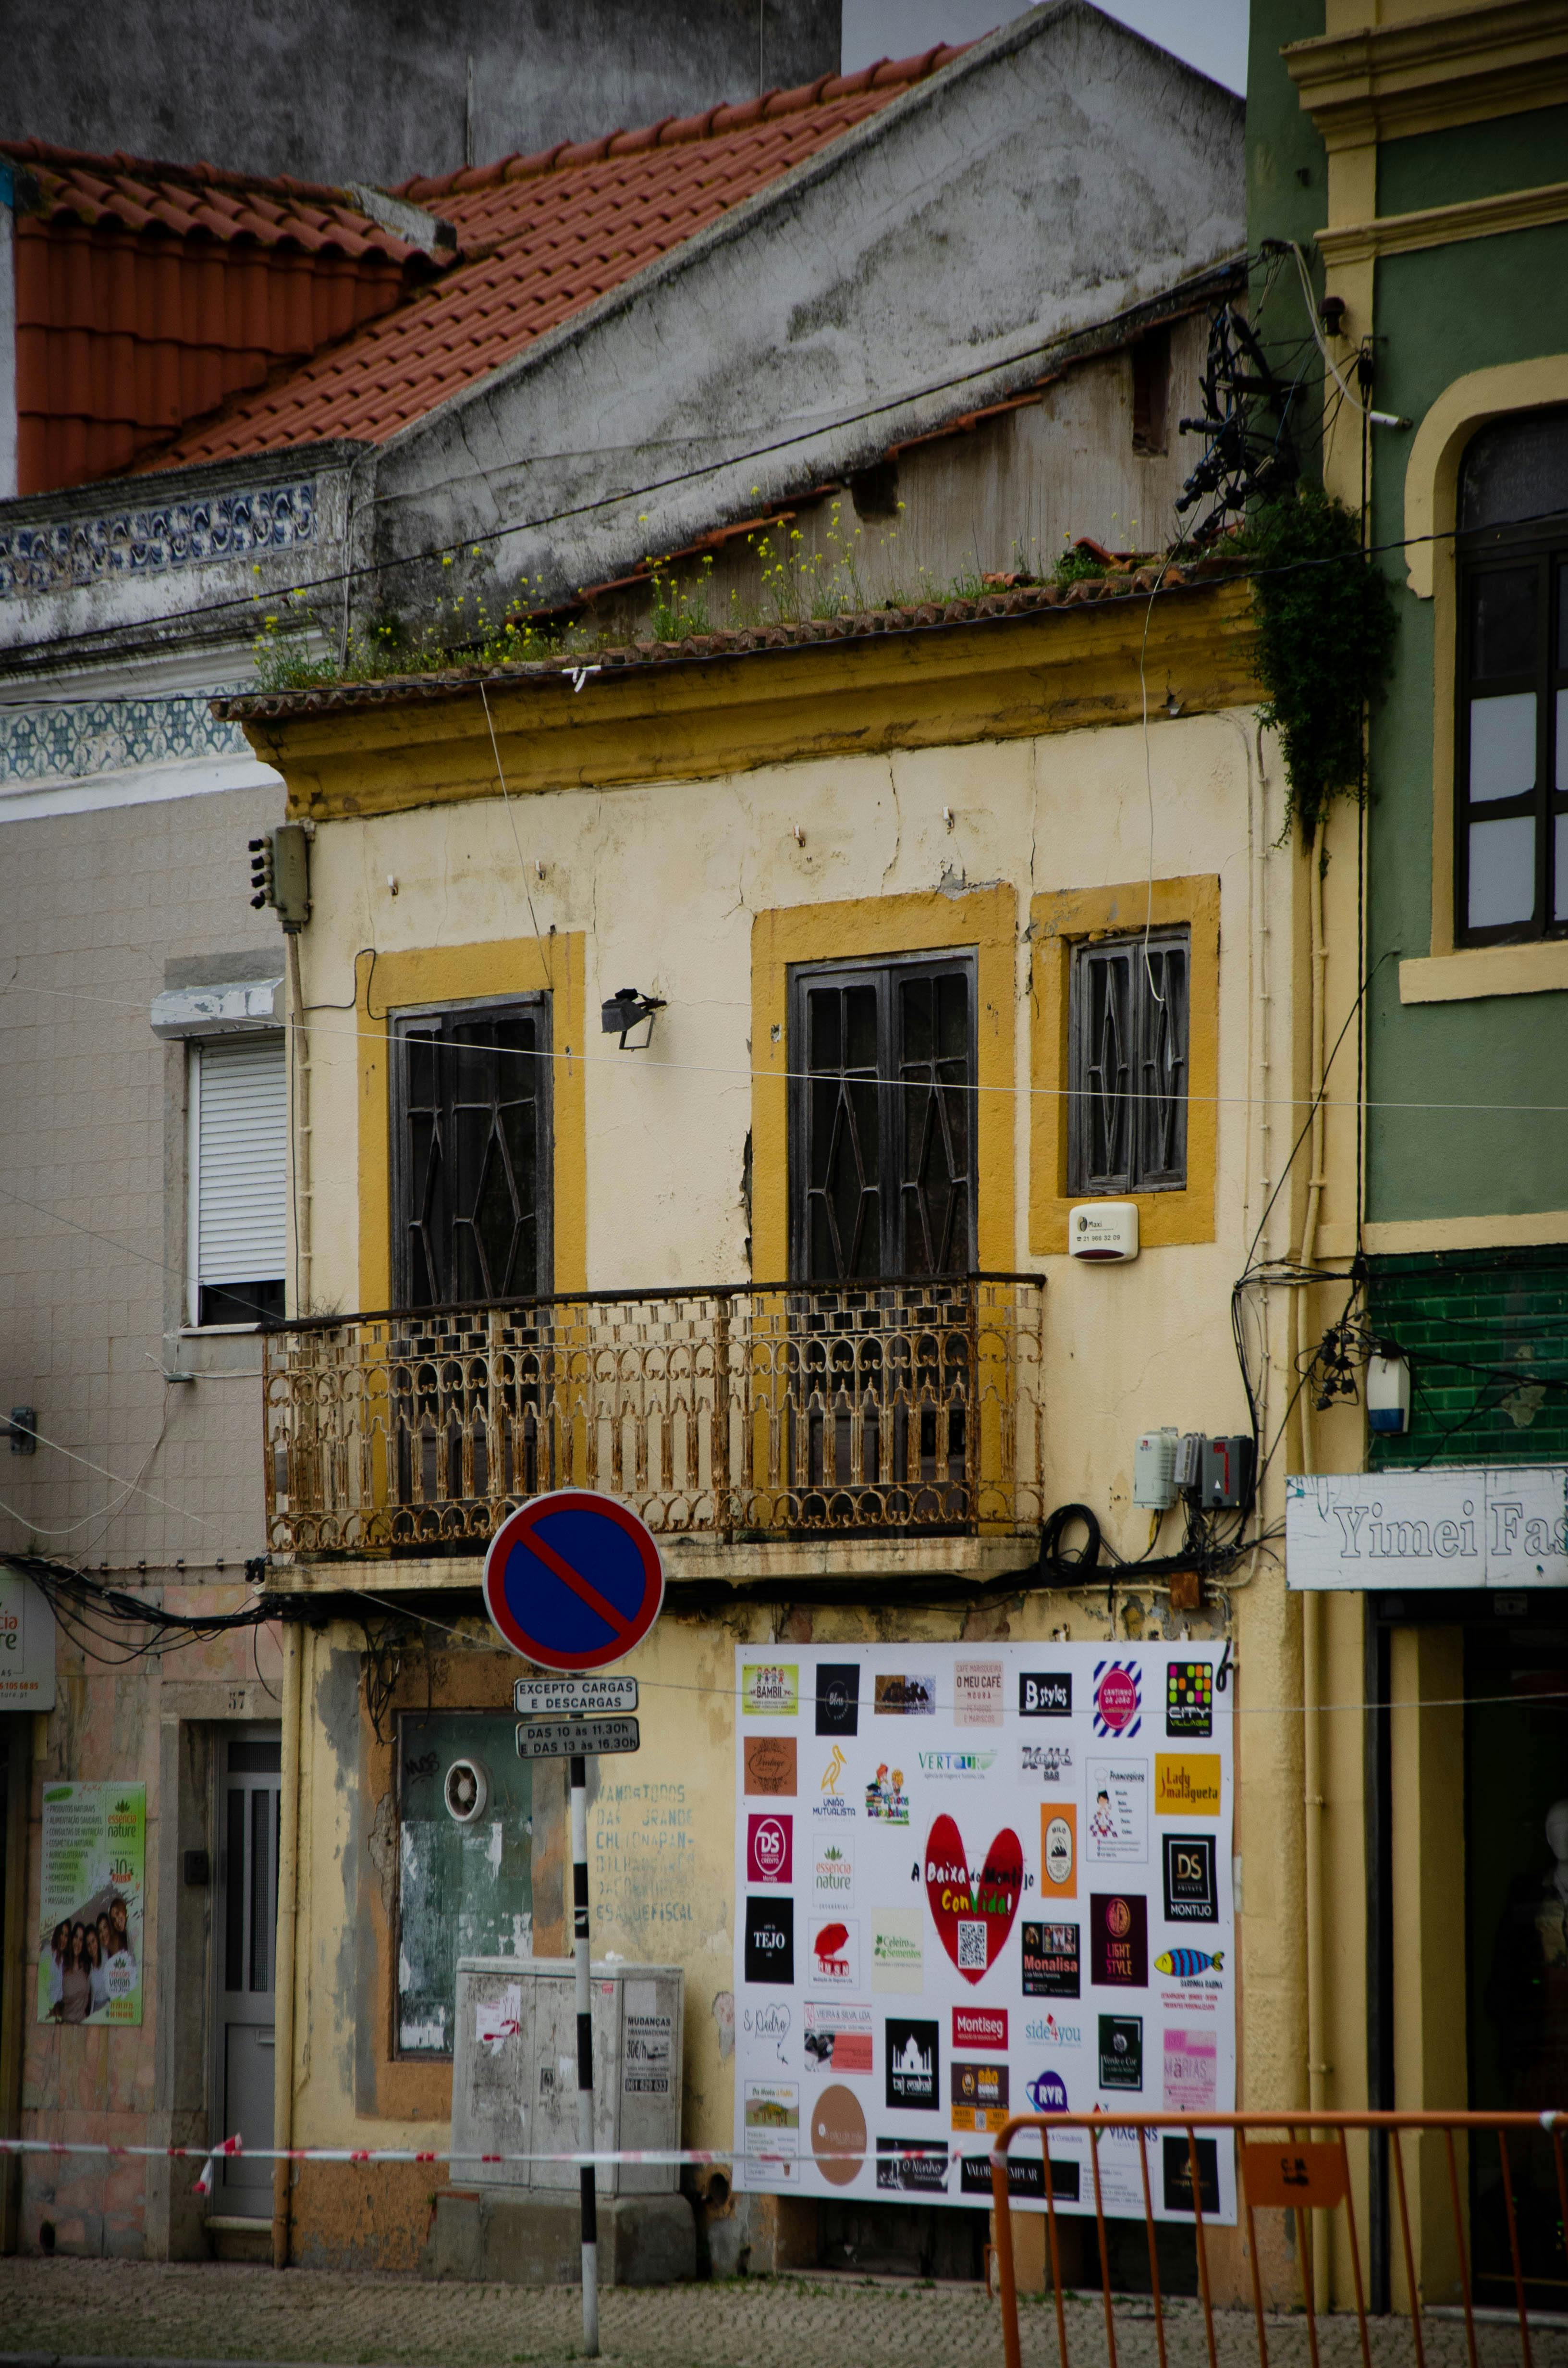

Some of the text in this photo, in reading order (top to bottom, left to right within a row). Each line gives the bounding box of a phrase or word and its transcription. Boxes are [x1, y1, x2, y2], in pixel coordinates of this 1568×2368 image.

[1333, 1499, 1478, 1558] Yimei
[519, 1682, 634, 1695] EXCEPTO CARGAS
[956, 1674, 1002, 1689] O MEU CAFÉ
[756, 1686, 784, 1699] BAMBIL
[967, 1691, 992, 1700] MOURA
[1026, 1680, 1067, 1710] B styles
[531, 1697, 622, 1709] E DESCARGAS
[968, 1714, 995, 1724] MARISCOS
[1169, 1706, 1210, 1719] CITY
[1170, 1719, 1210, 1727] VILLAGE
[527, 1727, 552, 1740] DAS
[557, 1726, 570, 1738] 10
[520, 1737, 637, 1755] E DAS 13 às 16.30h
[1043, 1771, 1060, 1781] BAR
[1167, 1766, 1190, 1788] Lady
[1166, 1785, 1218, 1803] malagueta
[49, 1805, 95, 1813] PRODUTOS NATURAIS
[823, 1797, 845, 1807] UNIÃO
[812, 1807, 856, 1816] MUTUALISTA
[108, 1813, 137, 1825] essencia
[49, 1827, 74, 1836] CONSULTAS
[108, 1825, 136, 1838] nature
[1052, 1826, 1066, 1835] MILO
[74, 1839, 94, 1848] NATURAL
[757, 1831, 780, 1854] DS
[115, 1859, 128, 1875] 10
[816, 1860, 851, 1874] essencia
[1177, 1853, 1202, 1880] DS
[816, 1874, 851, 1890] nature
[911, 1862, 920, 1883] A
[927, 1862, 967, 1885] Baixa
[984, 1867, 1034, 1890] Montijo
[1170, 1904, 1212, 1917] MONTIJO
[754, 1931, 785, 1949] TEJO
[882, 1936, 909, 1949] Celeiro
[886, 1949, 921, 1960] Sementes
[1106, 1943, 1131, 1959] LIGHT
[1024, 1954, 1078, 1973] Monalisa
[1106, 1960, 1133, 1976] STYLE
[109, 1978, 130, 1989] vegan
[816, 2010, 835, 2019] VIEIRA
[627, 2017, 671, 2027] MUDANÇAS
[957, 2015, 1004, 2039] Montiseg
[1025, 2018, 1081, 2045] side4you
[626, 2040, 647, 2061] 30€/h
[1103, 2054, 1120, 2065] Verde
[1126, 2056, 1137, 2066] Cor
[893, 2076, 932, 2096] taj mahal
[1039, 2084, 1064, 2105] RVR
[1109, 2126, 1158, 2142] VIAGNS
[903, 2160, 943, 2174] O Ninho
[965, 2162, 991, 2177] VALOR
